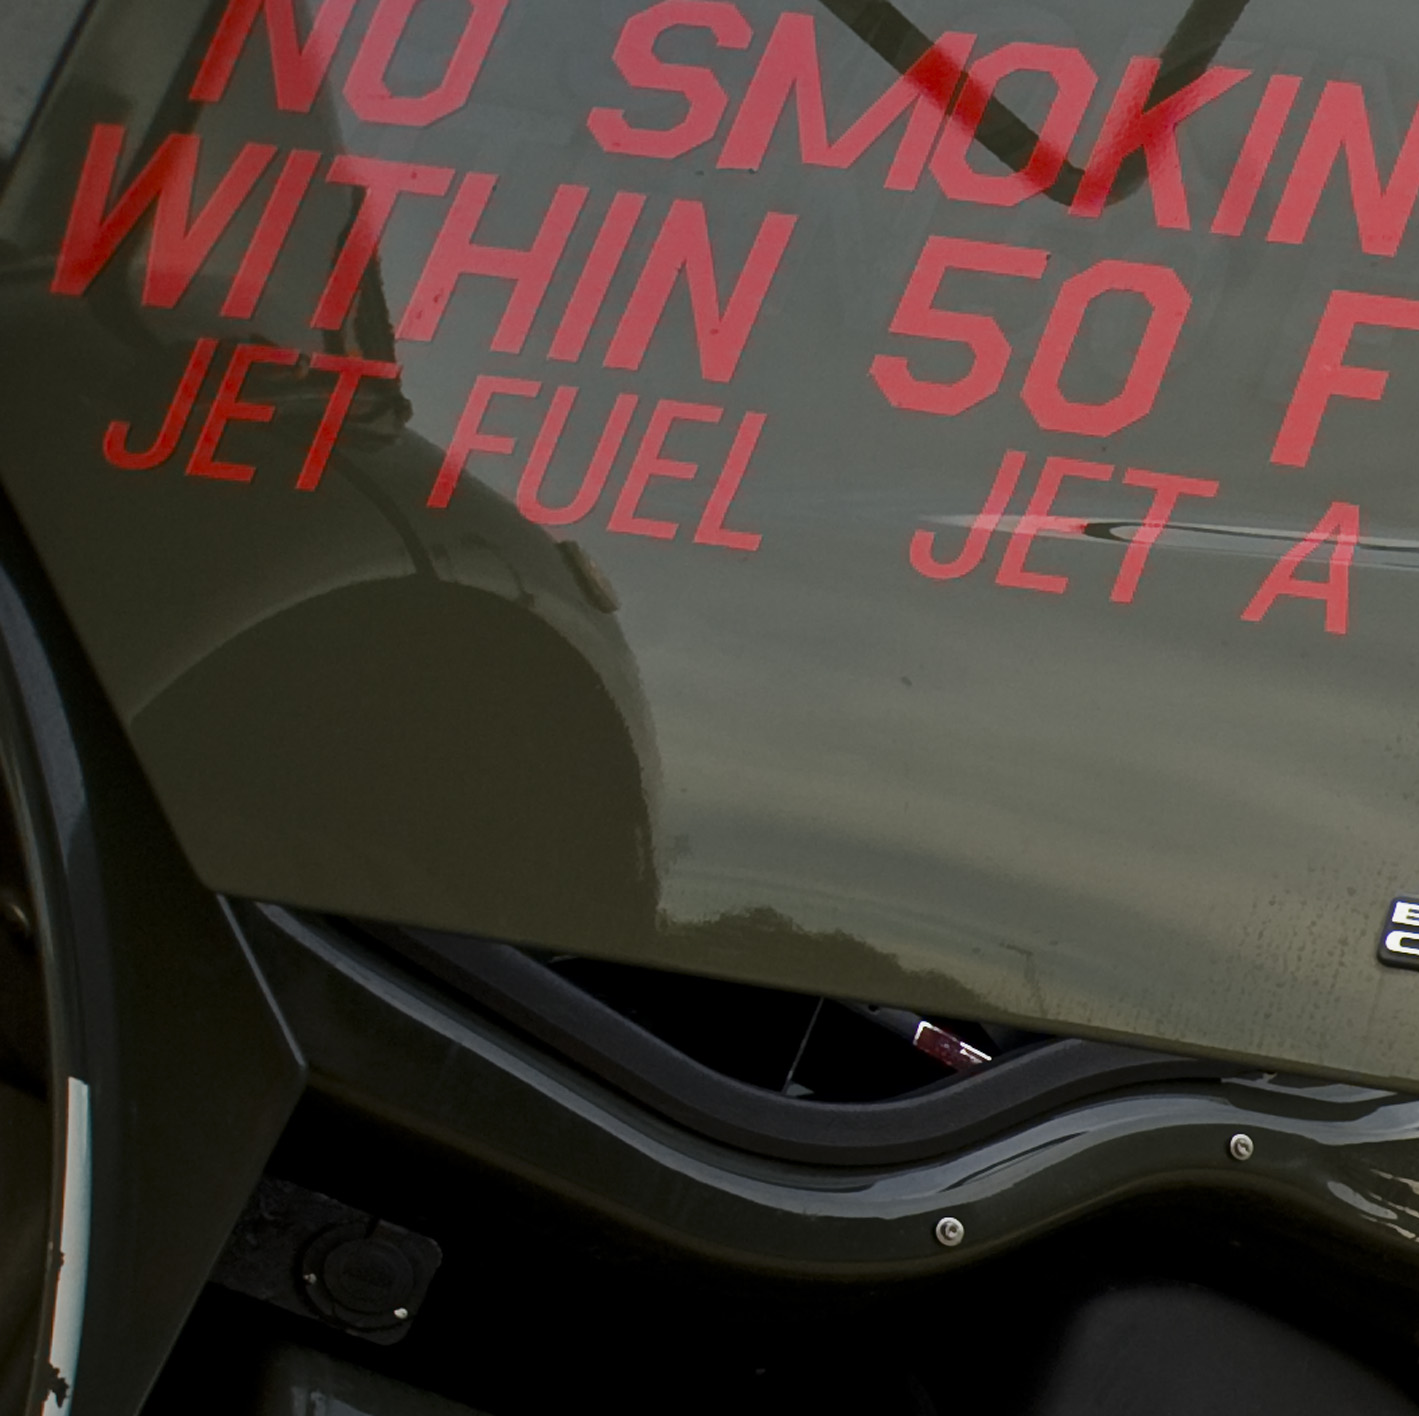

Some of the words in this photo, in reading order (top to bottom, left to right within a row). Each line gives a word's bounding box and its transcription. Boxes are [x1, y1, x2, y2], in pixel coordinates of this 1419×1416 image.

[188, 0, 509, 127] NO
[49, 123, 798, 383] WITHIN
[869, 235, 1192, 438] 50
[102, 338, 401, 492] JET
[426, 376, 767, 552] FUEL
[909, 450, 1220, 605] JET
[1241, 500, 1361, 636] A
